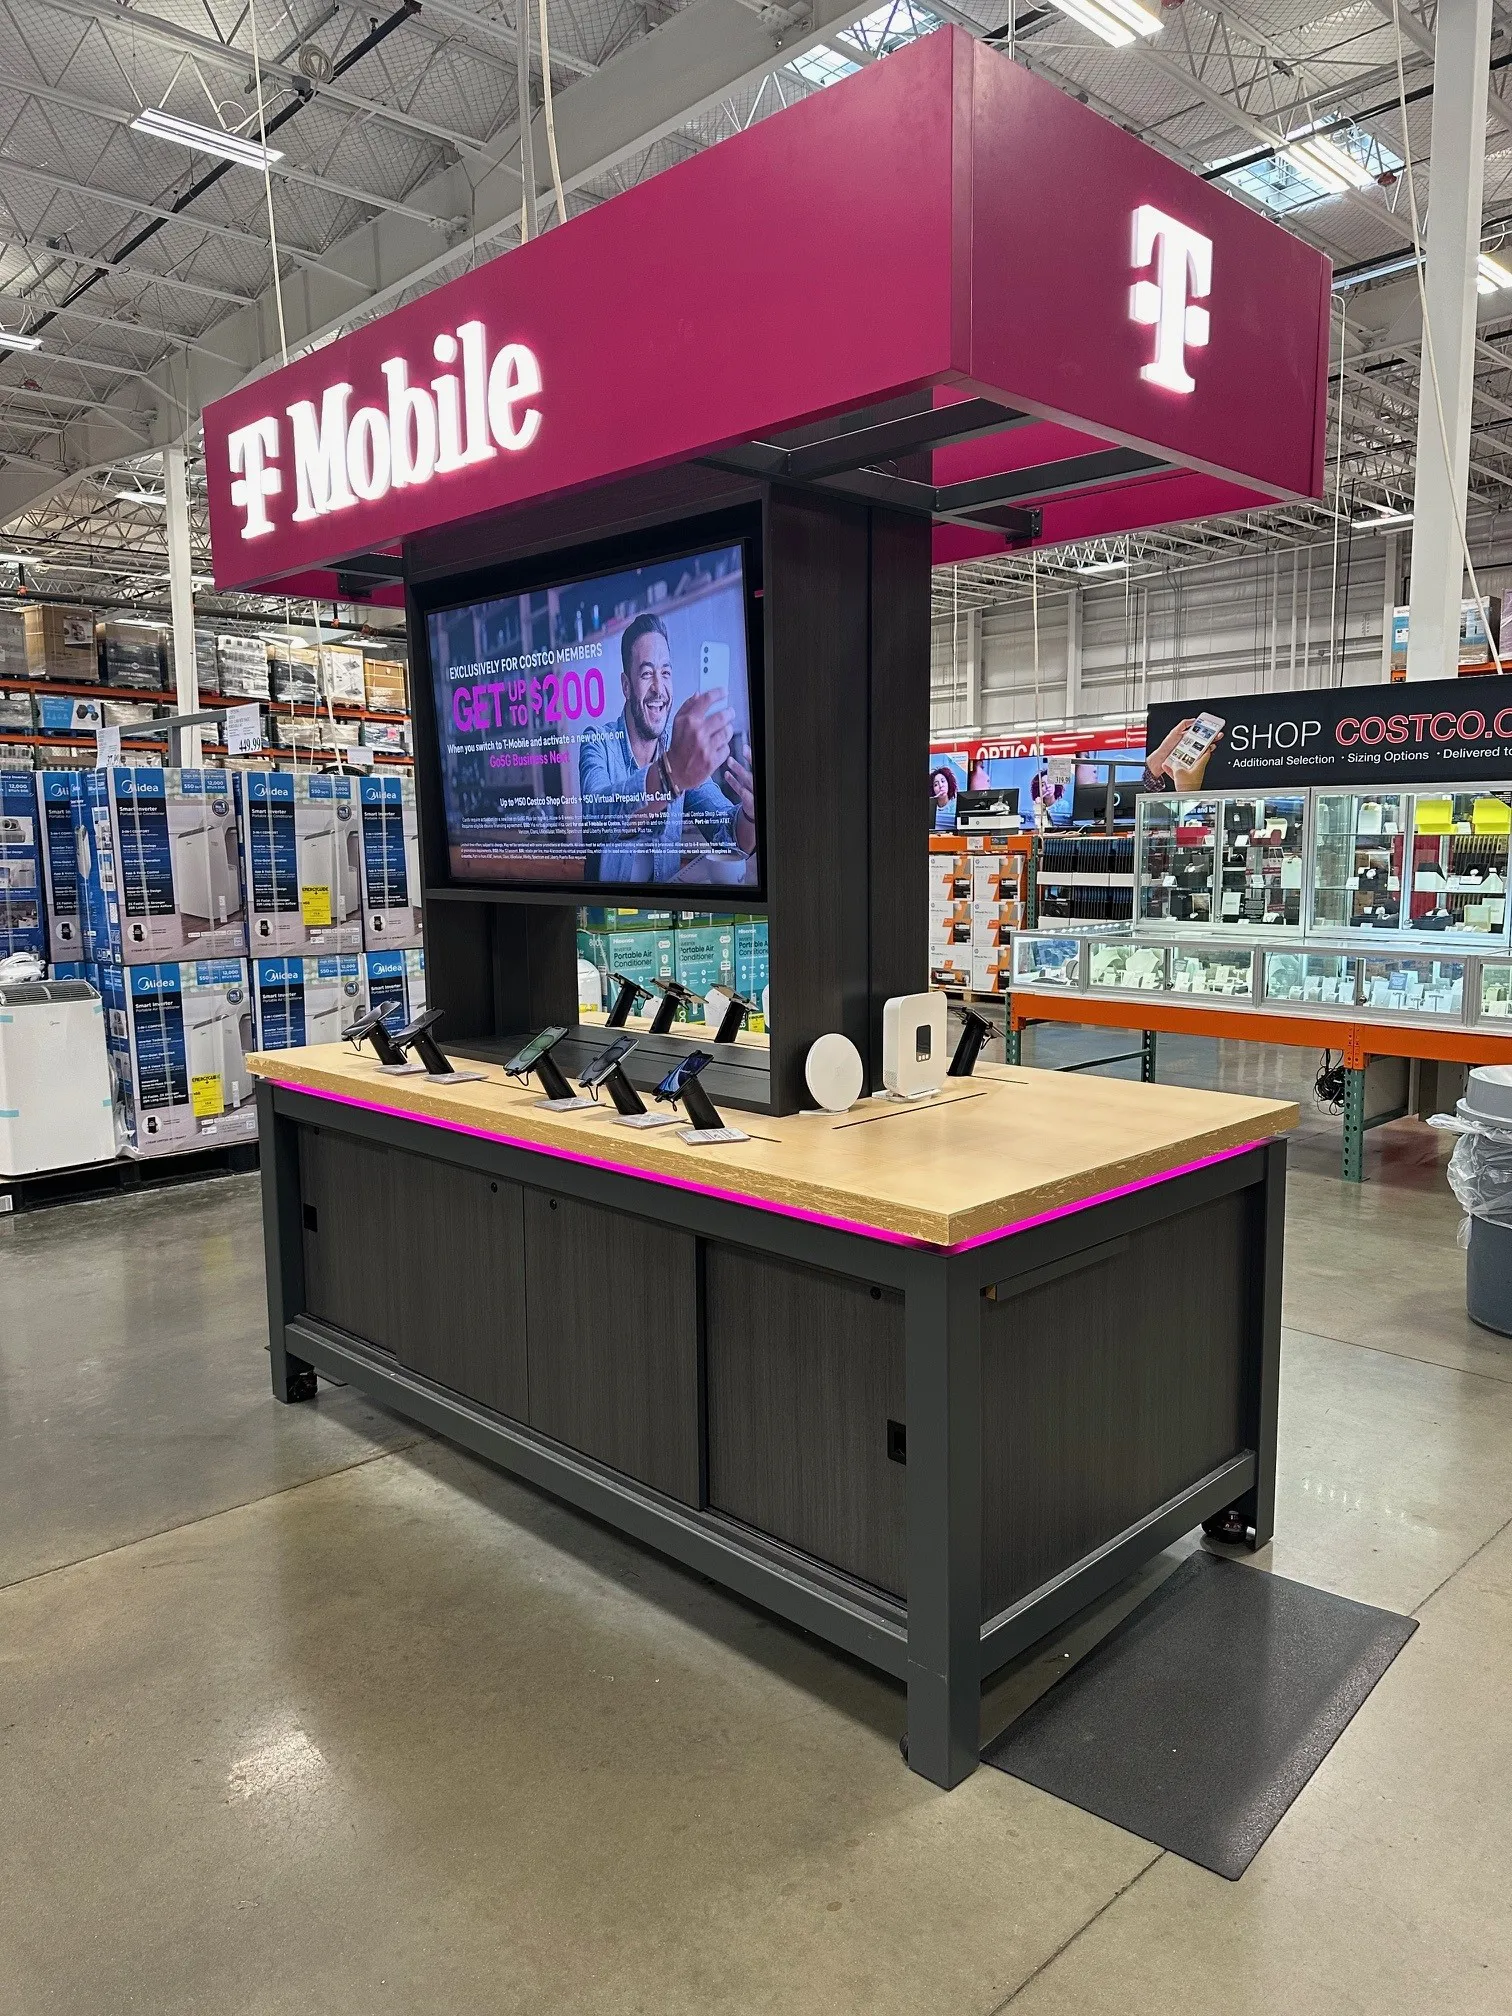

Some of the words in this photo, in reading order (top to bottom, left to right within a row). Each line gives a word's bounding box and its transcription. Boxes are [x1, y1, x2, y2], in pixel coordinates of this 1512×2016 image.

[450, 660, 500, 679] EXCLUSIVELY
[501, 657, 518, 671] FOR
[519, 651, 555, 669] COSTCO
[557, 643, 602, 663] MEMBERS
[454, 682, 505, 732] GET
[509, 680, 526, 702] UP
[530, 668, 605, 721] $200
[509, 704, 528, 726] TO
[1230, 721, 1321, 751] SHOP
[1335, 708, 1512, 746] COSTCO.C
[447, 744, 464, 754] When
[464, 744, 475, 753] you
[476, 740, 495, 751] switch
[496, 740, 502, 750] to
[503, 738, 529, 749] T-Mobile
[530, 736, 542, 747] and
[543, 734, 570, 746] activate
[577, 734, 591, 742] new
[592, 731, 614, 744] phone
[616, 731, 624, 740] on
[1347, 752, 1381, 764] Sizing
[1384, 751, 1429, 762] Options
[1443, 747, 1500, 759] Delivered
[490, 754, 511, 768] Go5G
[513, 752, 548, 766] Business
[1233, 757, 1284, 768] Additional
[1286, 755, 1335, 766] Selection
[500, 798, 508, 808] Up
[527, 796, 545, 806] Costco
[546, 796, 560, 807] Shop
[561, 796, 577, 805] Cards
[594, 793, 615, 804] Virtual
[615, 792, 639, 804] Prepaid
[641, 792, 654, 802] Visa
[655, 791, 672, 801] Card
[613, 951, 642, 960] Portable
[643, 949, 653, 957] Air
[373, 962, 402, 975] Midea
[614, 959, 653, 968] Conditioner
[265, 969, 298, 982] Midea
[138, 977, 174, 990] Midea
